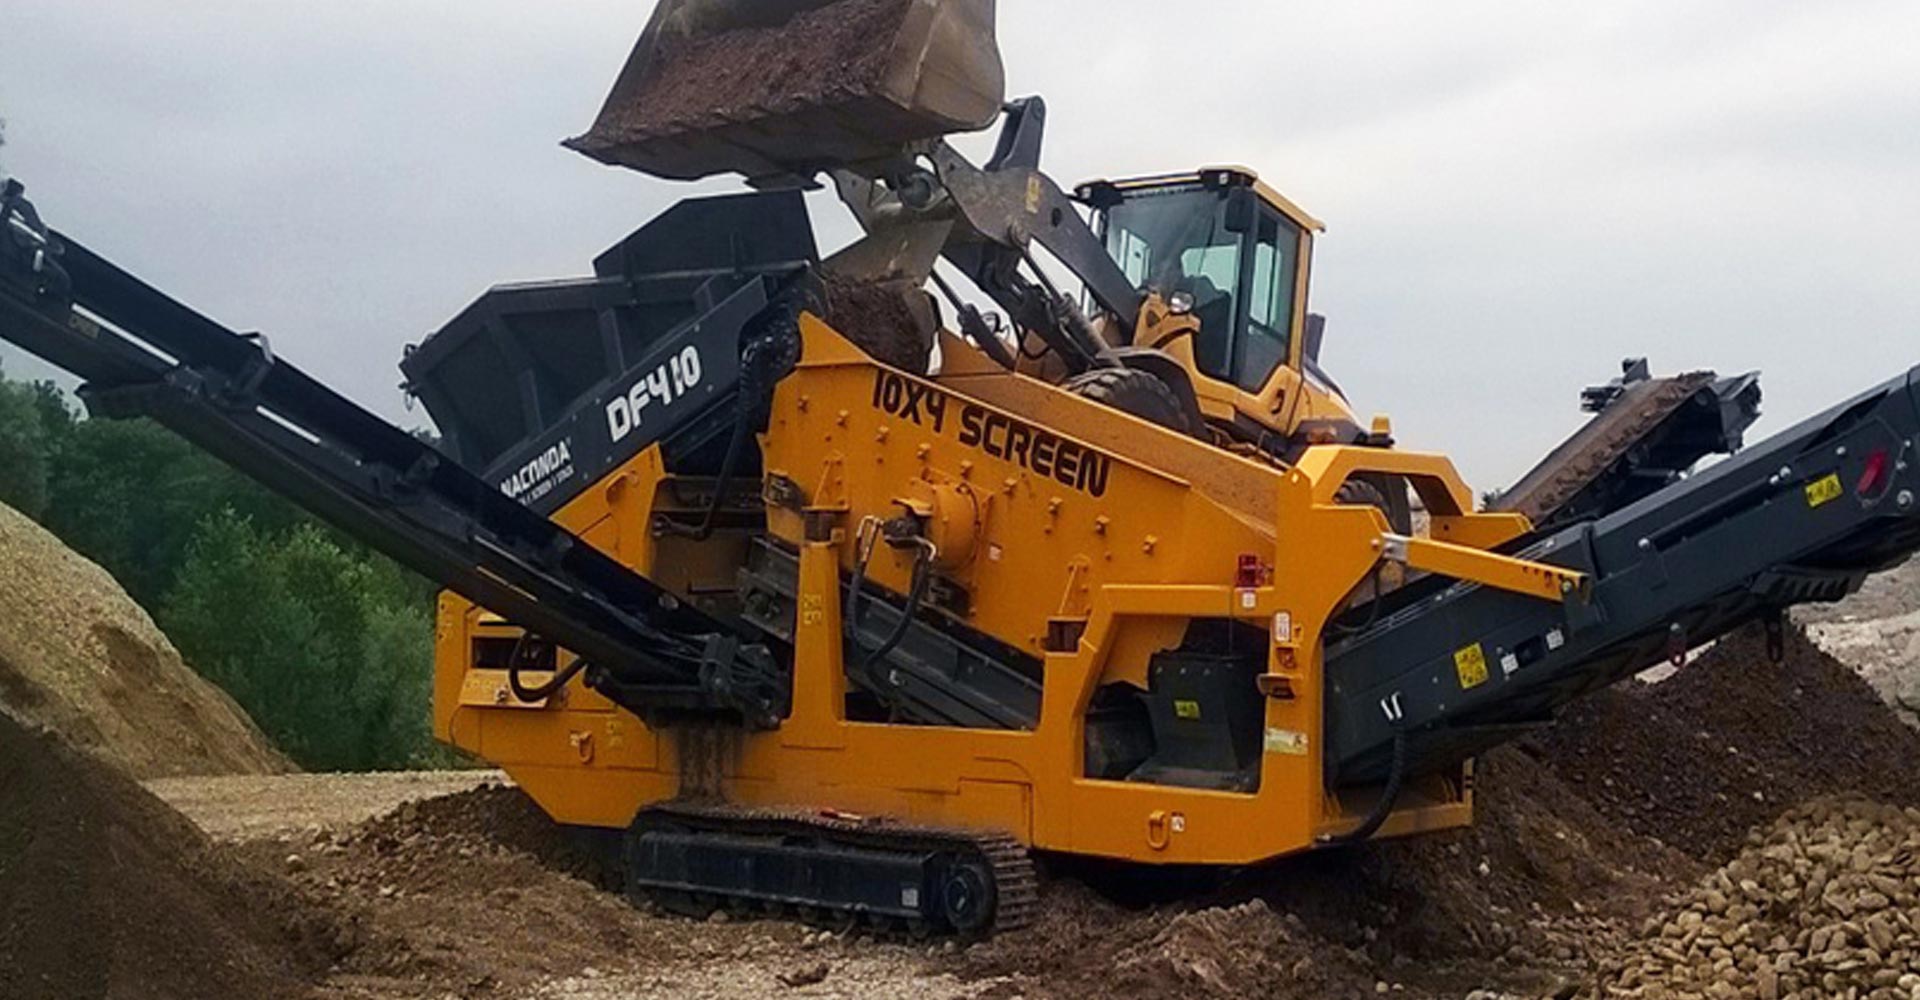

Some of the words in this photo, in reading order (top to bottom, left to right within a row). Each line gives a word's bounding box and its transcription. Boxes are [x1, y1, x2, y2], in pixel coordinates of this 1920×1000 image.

[606, 346, 701, 442] DF410
[873, 370, 945, 433] 10X4
[959, 406, 1109, 497] SCREEN
